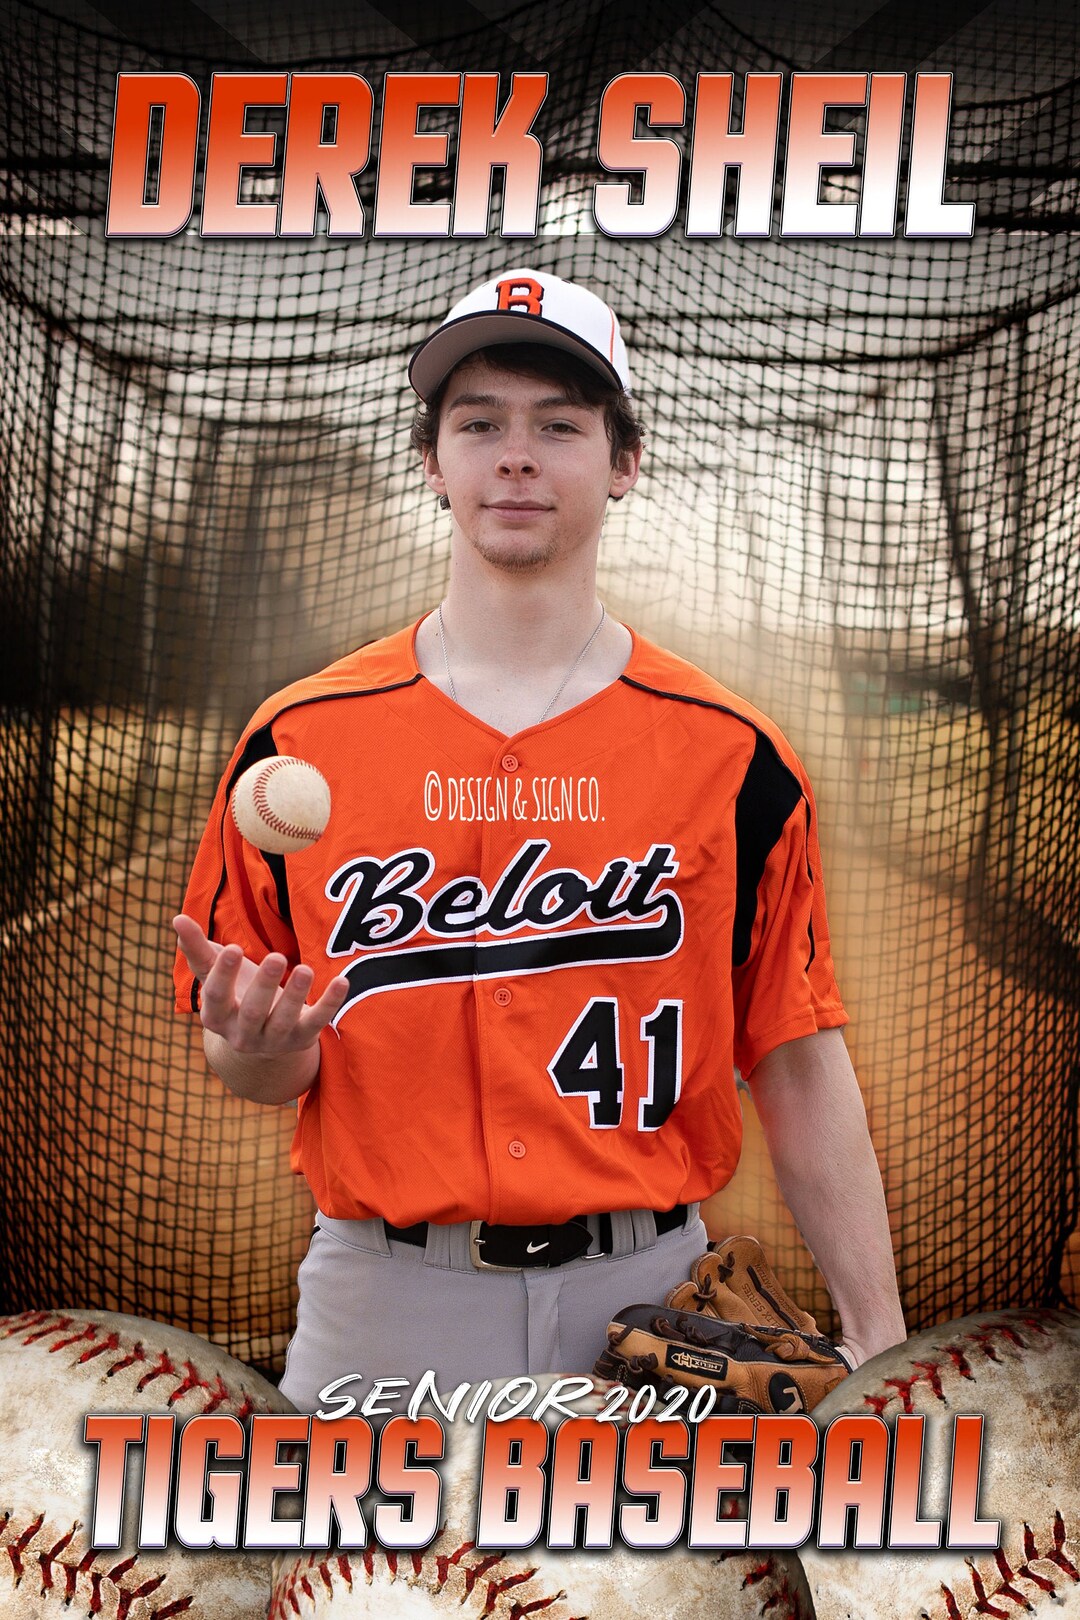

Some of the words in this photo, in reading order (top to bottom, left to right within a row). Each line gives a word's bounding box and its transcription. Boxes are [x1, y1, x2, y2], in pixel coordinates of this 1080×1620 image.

[496, 278, 544, 316] B
[325, 839, 680, 958] Beloit
[546, 997, 684, 1132] 41
[742, 1283, 766, 1313] SERIES
[694, 1360, 718, 1370] HELIX
